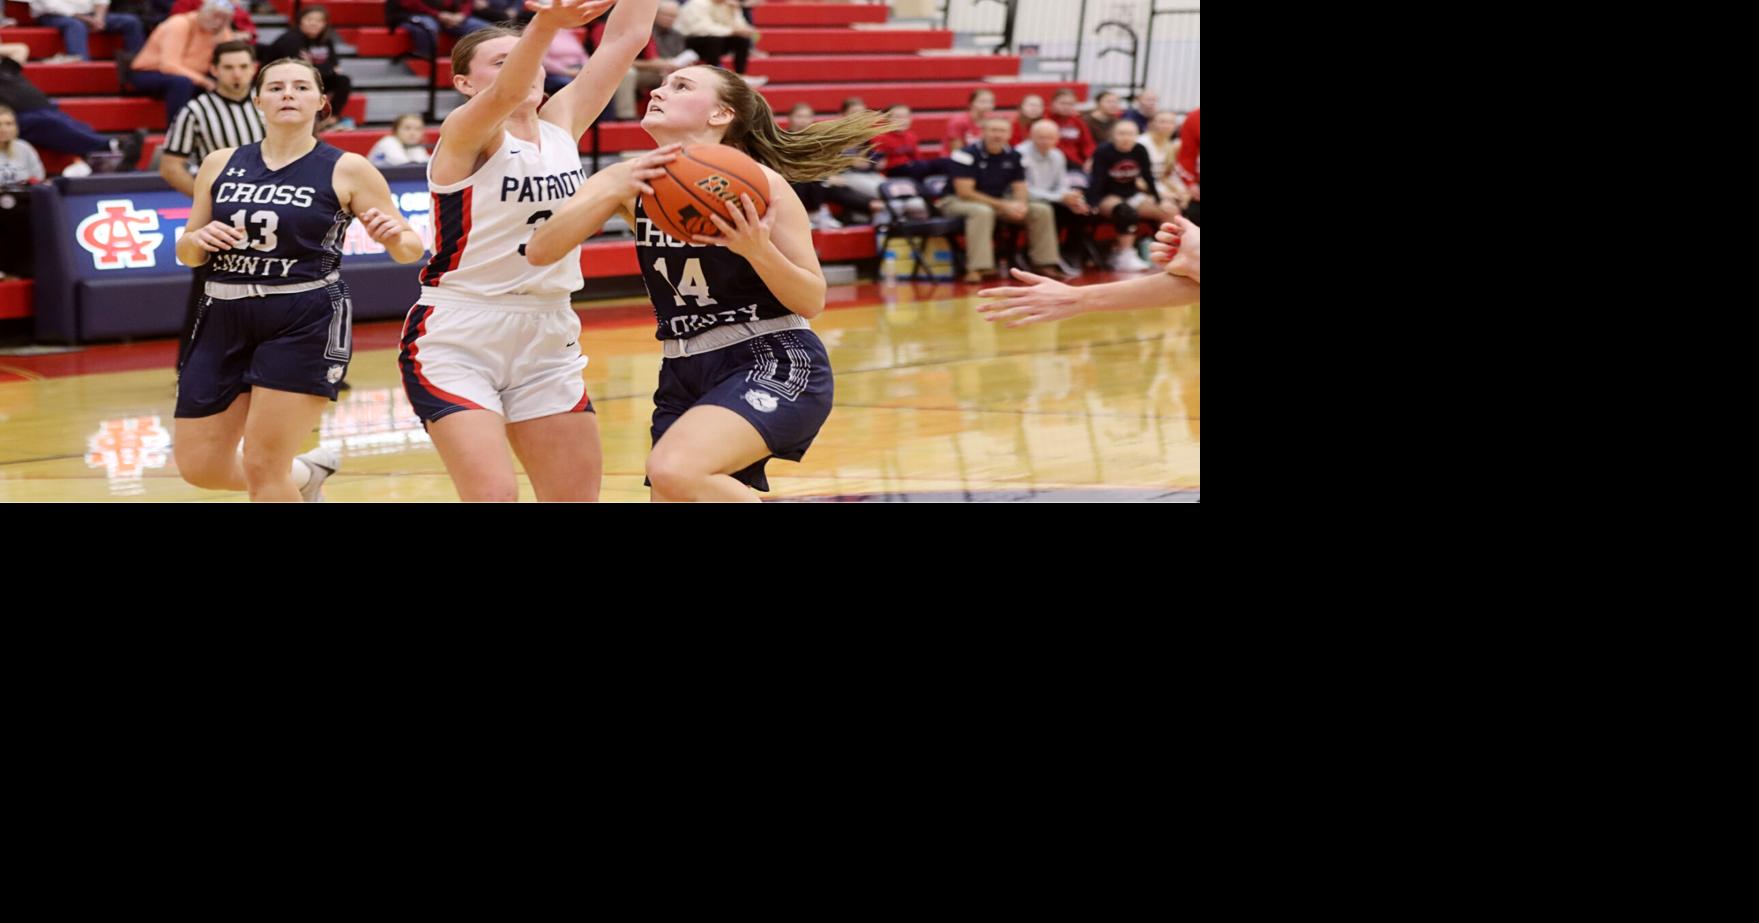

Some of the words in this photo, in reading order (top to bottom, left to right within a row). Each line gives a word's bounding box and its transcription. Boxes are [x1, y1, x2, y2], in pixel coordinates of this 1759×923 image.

[216, 182, 316, 208] CROSS
[500, 168, 585, 203] PATRIOT
[230, 209, 279, 252] 13
[653, 257, 718, 307] 14
